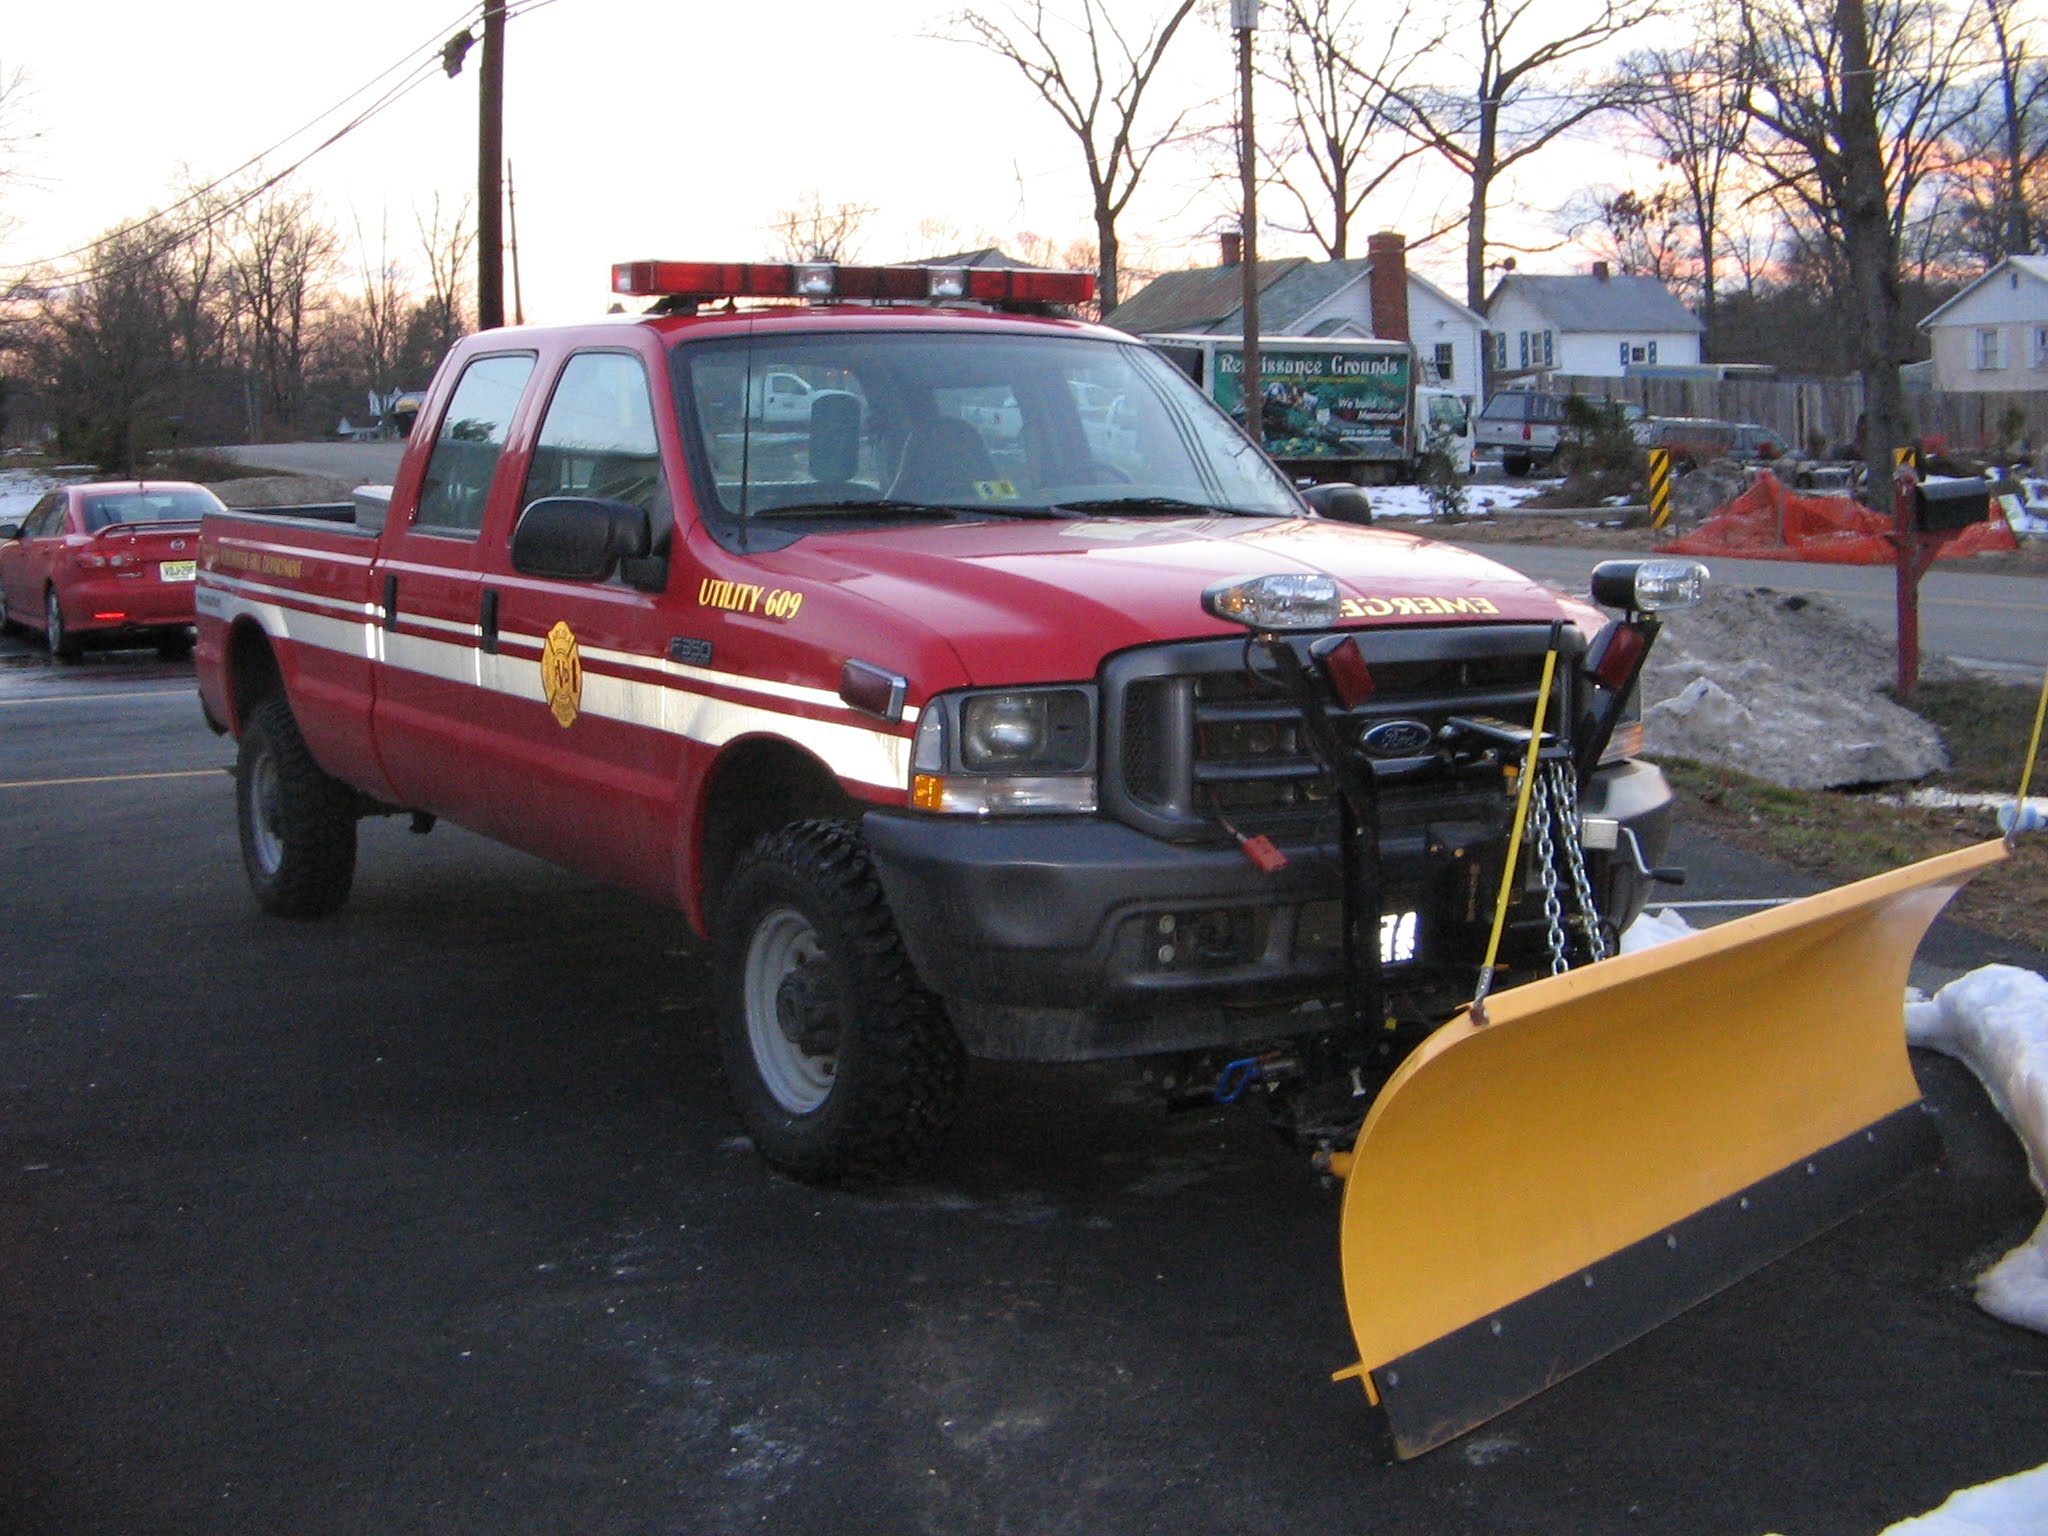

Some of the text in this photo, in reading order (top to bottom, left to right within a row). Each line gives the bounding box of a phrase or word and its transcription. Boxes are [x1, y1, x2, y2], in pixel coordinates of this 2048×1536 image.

[1221, 353, 1399, 376] Reissance Grounds
[698, 578, 803, 620] UTILITY 609
